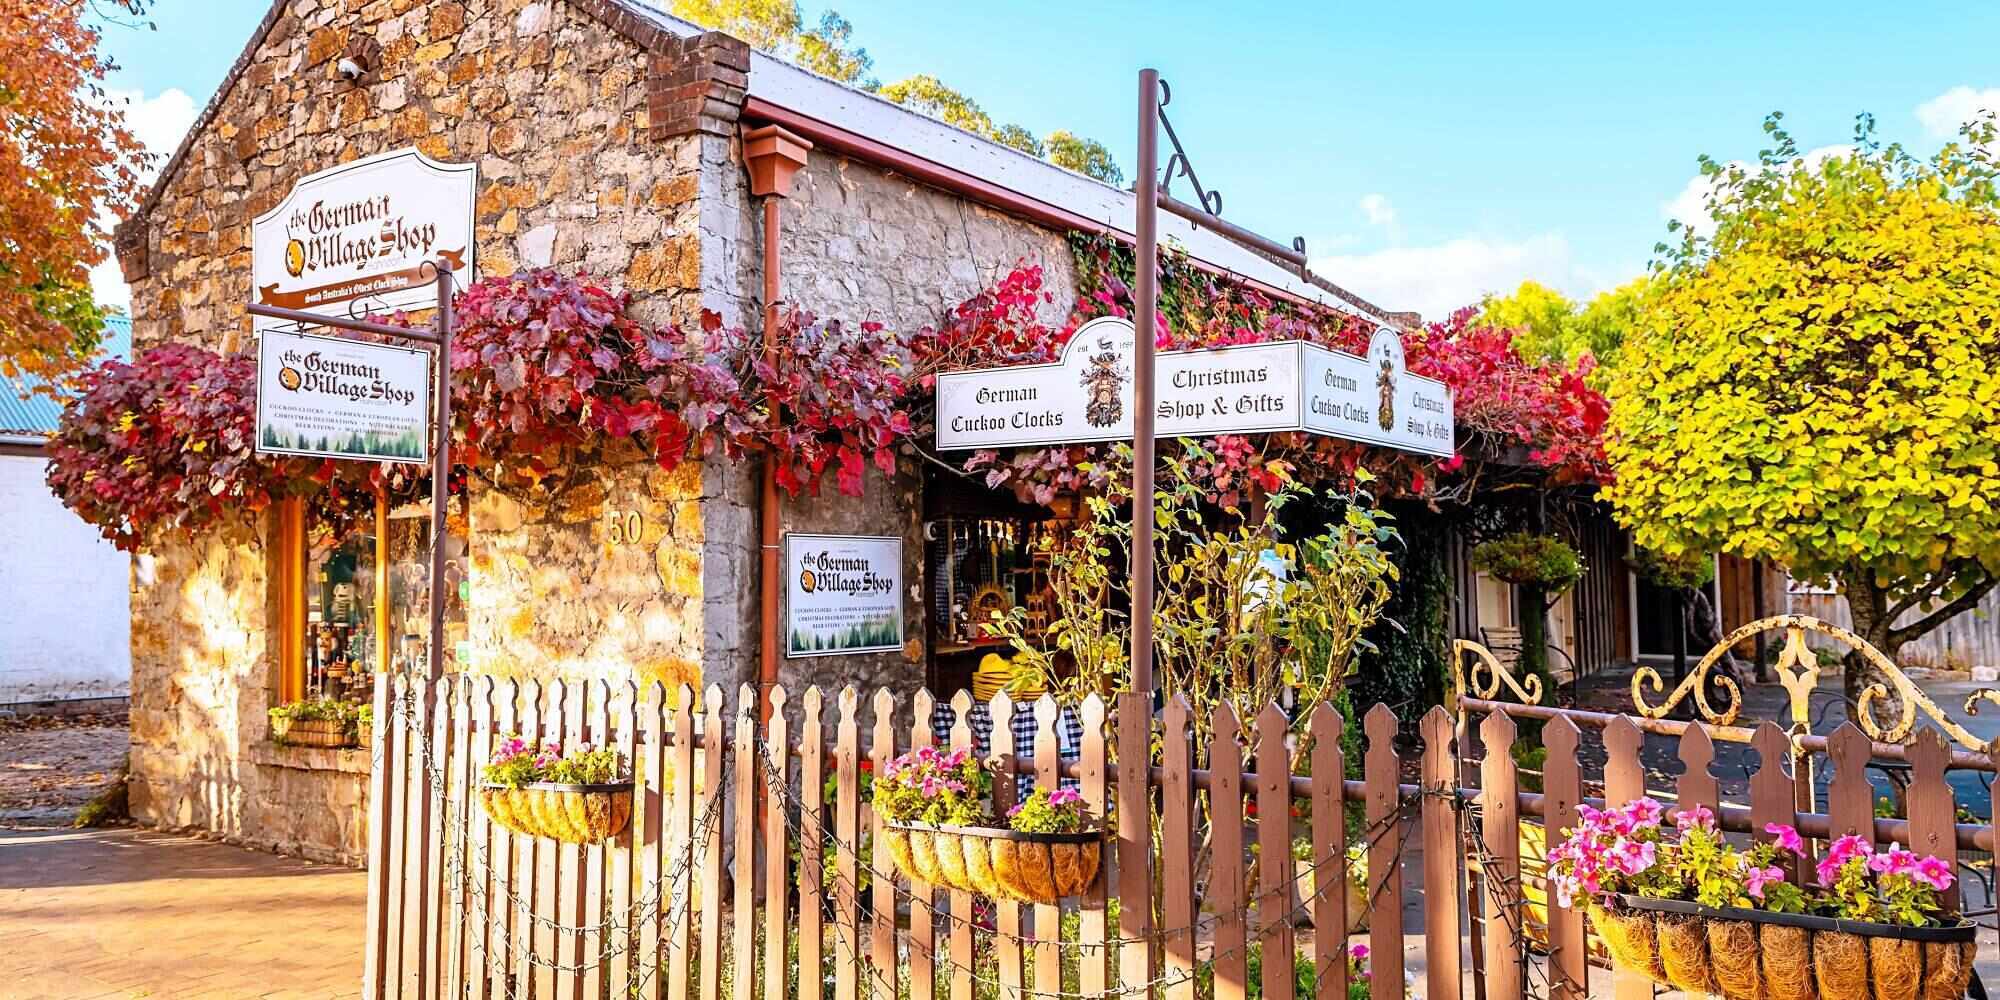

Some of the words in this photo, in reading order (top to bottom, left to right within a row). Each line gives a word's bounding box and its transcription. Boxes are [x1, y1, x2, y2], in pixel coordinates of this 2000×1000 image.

[290, 208, 307, 231] the
[308, 194, 391, 235] German
[308, 231, 376, 271] Village
[379, 216, 436, 259] Shop
[284, 349, 302, 365] the
[304, 351, 381, 380] German
[303, 372, 368, 401] Village
[369, 380, 415, 406] Shop
[1172, 366, 1268, 390] Christmas
[1324, 368, 1357, 392] German
[975, 386, 1038, 405] German
[1157, 400, 1205, 420] Shop
[1211, 396, 1228, 415] &
[1235, 394, 1285, 414] Gifts
[1412, 391, 1444, 414] Christmas
[951, 415, 1005, 433] Cuckoo
[1011, 410, 1064, 429] Clocks
[1311, 395, 1341, 418] Cuckoo
[1343, 402, 1369, 423] Clocks
[1407, 416, 1424, 437] Shop
[1434, 423, 1449, 440] Gifts
[609, 510, 643, 545] 50
[803, 551, 816, 567] the
[817, 550, 869, 571] German
[817, 572, 862, 596] Village
[862, 571, 893, 595] Shop
